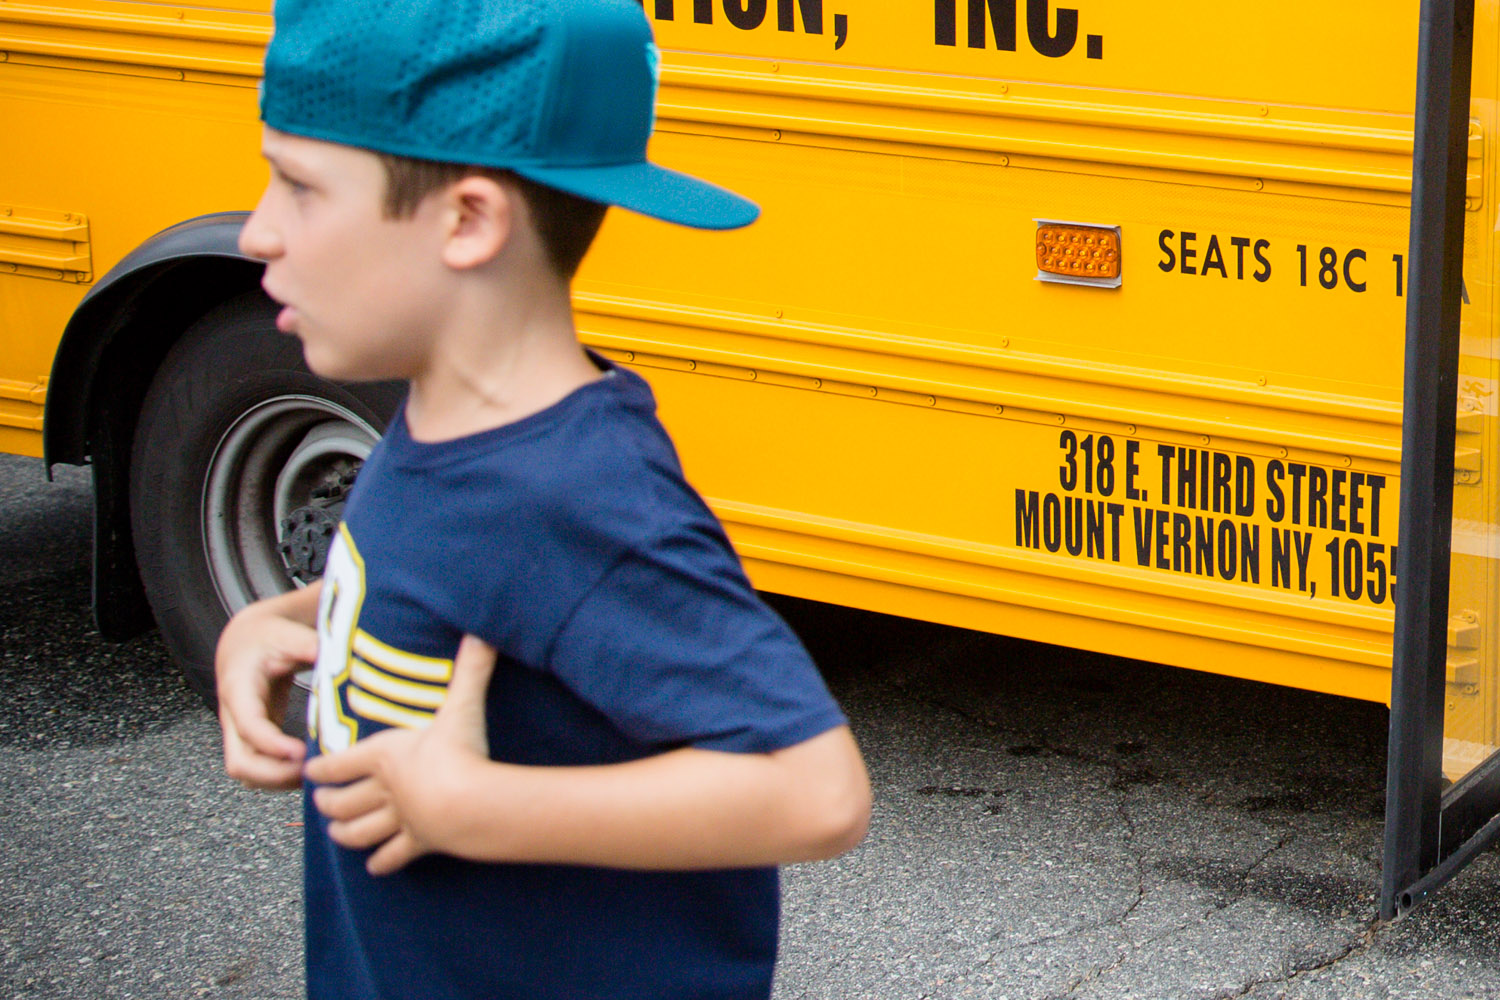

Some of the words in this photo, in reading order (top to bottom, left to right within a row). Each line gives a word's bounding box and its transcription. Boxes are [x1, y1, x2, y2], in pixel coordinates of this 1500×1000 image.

[1158, 229, 1272, 283] SEATS
[1296, 244, 1367, 293] 18C
[1059, 430, 1115, 497] 318
[1126, 440, 1148, 503] E.
[1157, 445, 1256, 517] THIRD
[1266, 459, 1386, 537] STREET
[1015, 488, 1124, 562] MOUNT
[1133, 506, 1260, 584] VERNON
[1271, 528, 1317, 600] NY,
